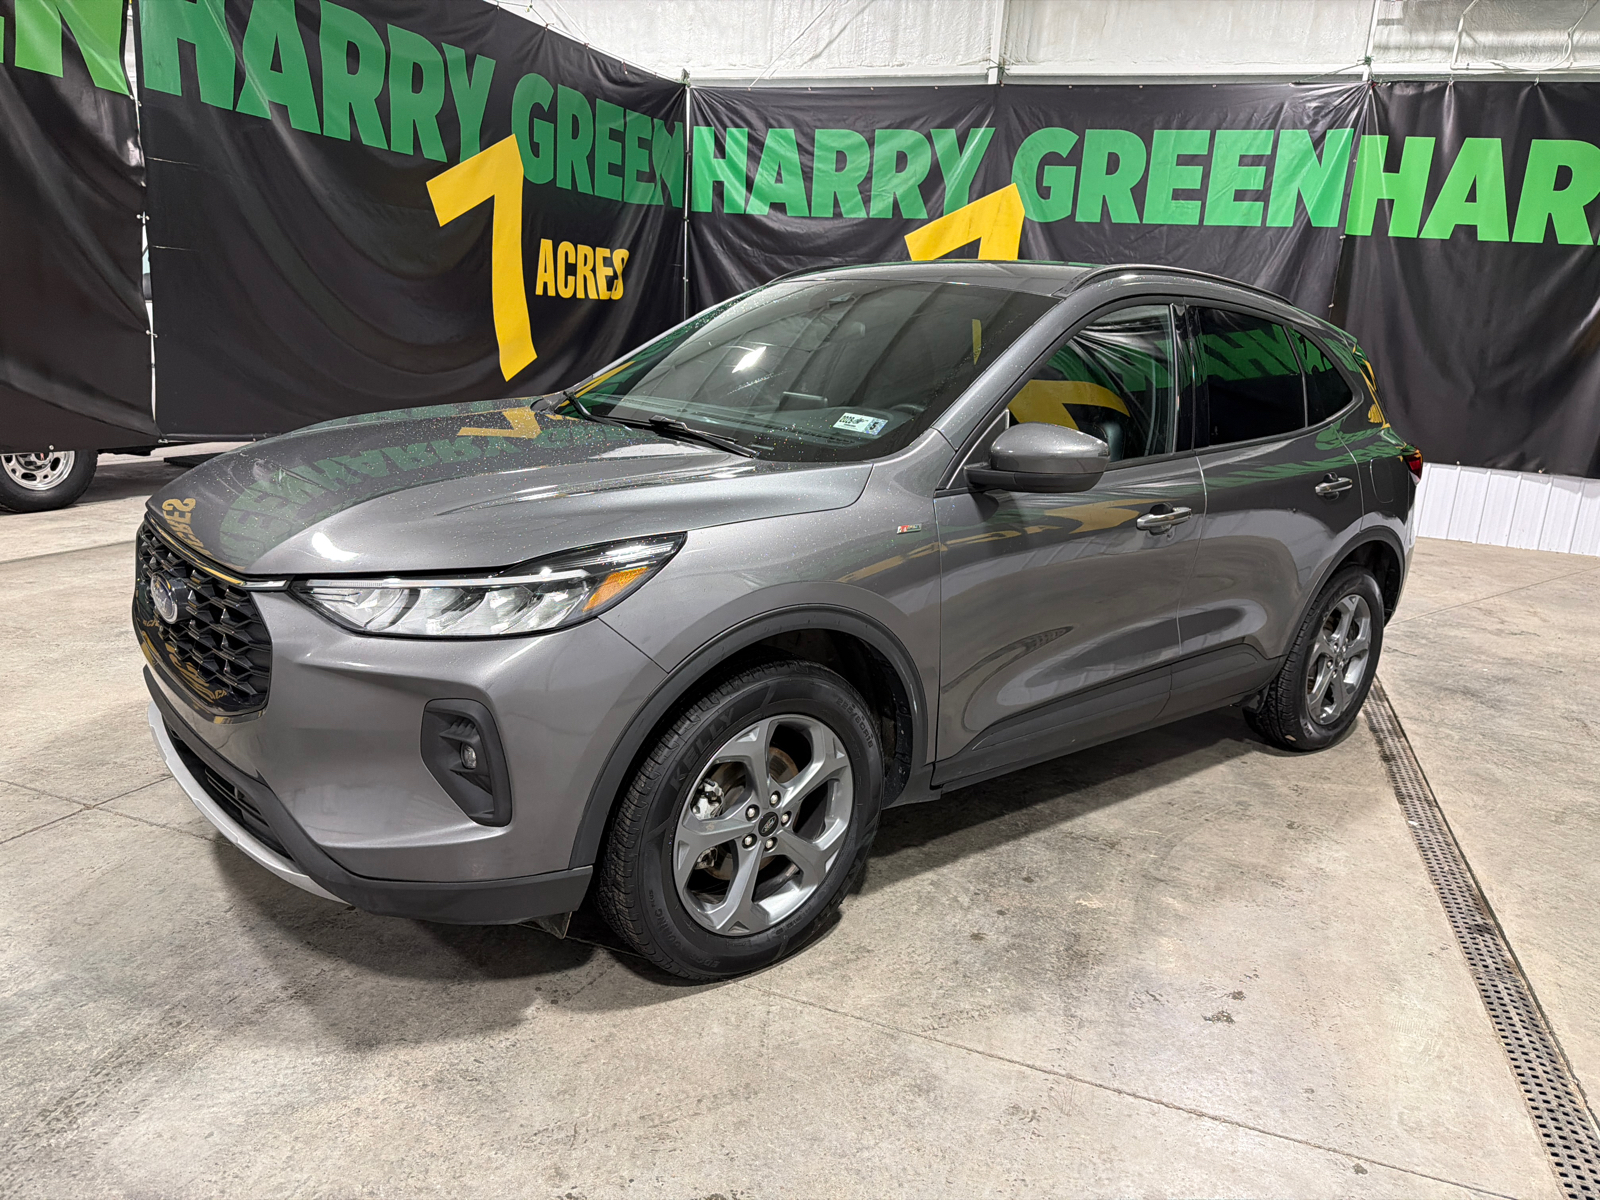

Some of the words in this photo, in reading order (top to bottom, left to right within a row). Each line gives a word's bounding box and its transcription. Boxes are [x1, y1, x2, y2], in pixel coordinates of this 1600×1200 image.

[139, 0, 496, 163] HARRY
[512, 73, 683, 208] GREEN
[691, 125, 995, 219] HARRY
[1010, 126, 1354, 228] GREEN
[1345, 134, 1600, 246] HAR
[427, 134, 537, 382] 7
[535, 238, 630, 301] ACRES
[669, 707, 735, 791] KELLY
